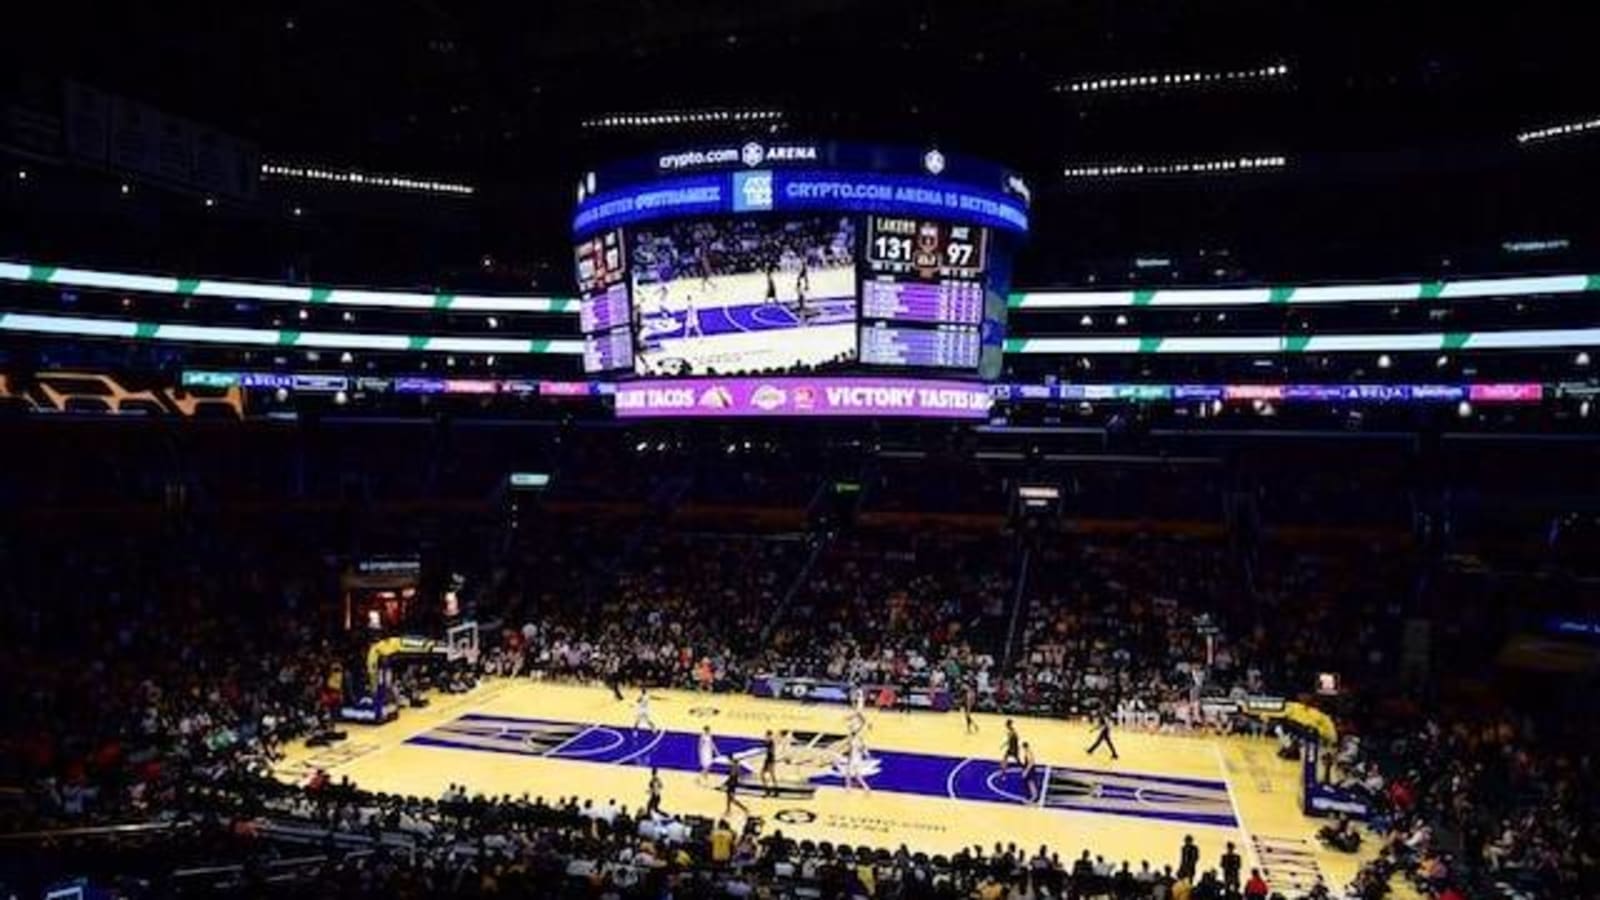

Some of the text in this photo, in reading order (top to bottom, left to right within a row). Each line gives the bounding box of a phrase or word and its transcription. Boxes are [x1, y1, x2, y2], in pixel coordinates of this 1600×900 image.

[659, 146, 817, 169] crypto.com ARENA
[786, 181, 893, 200] CRYPTO.COM
[894, 186, 943, 206] ARENA
[944, 191, 958, 207] IS
[875, 236, 912, 260] 131
[947, 242, 973, 265] 97
[648, 388, 695, 408] TACOS
[826, 386, 915, 407] VICTORY
[919, 388, 968, 408] TASTES
